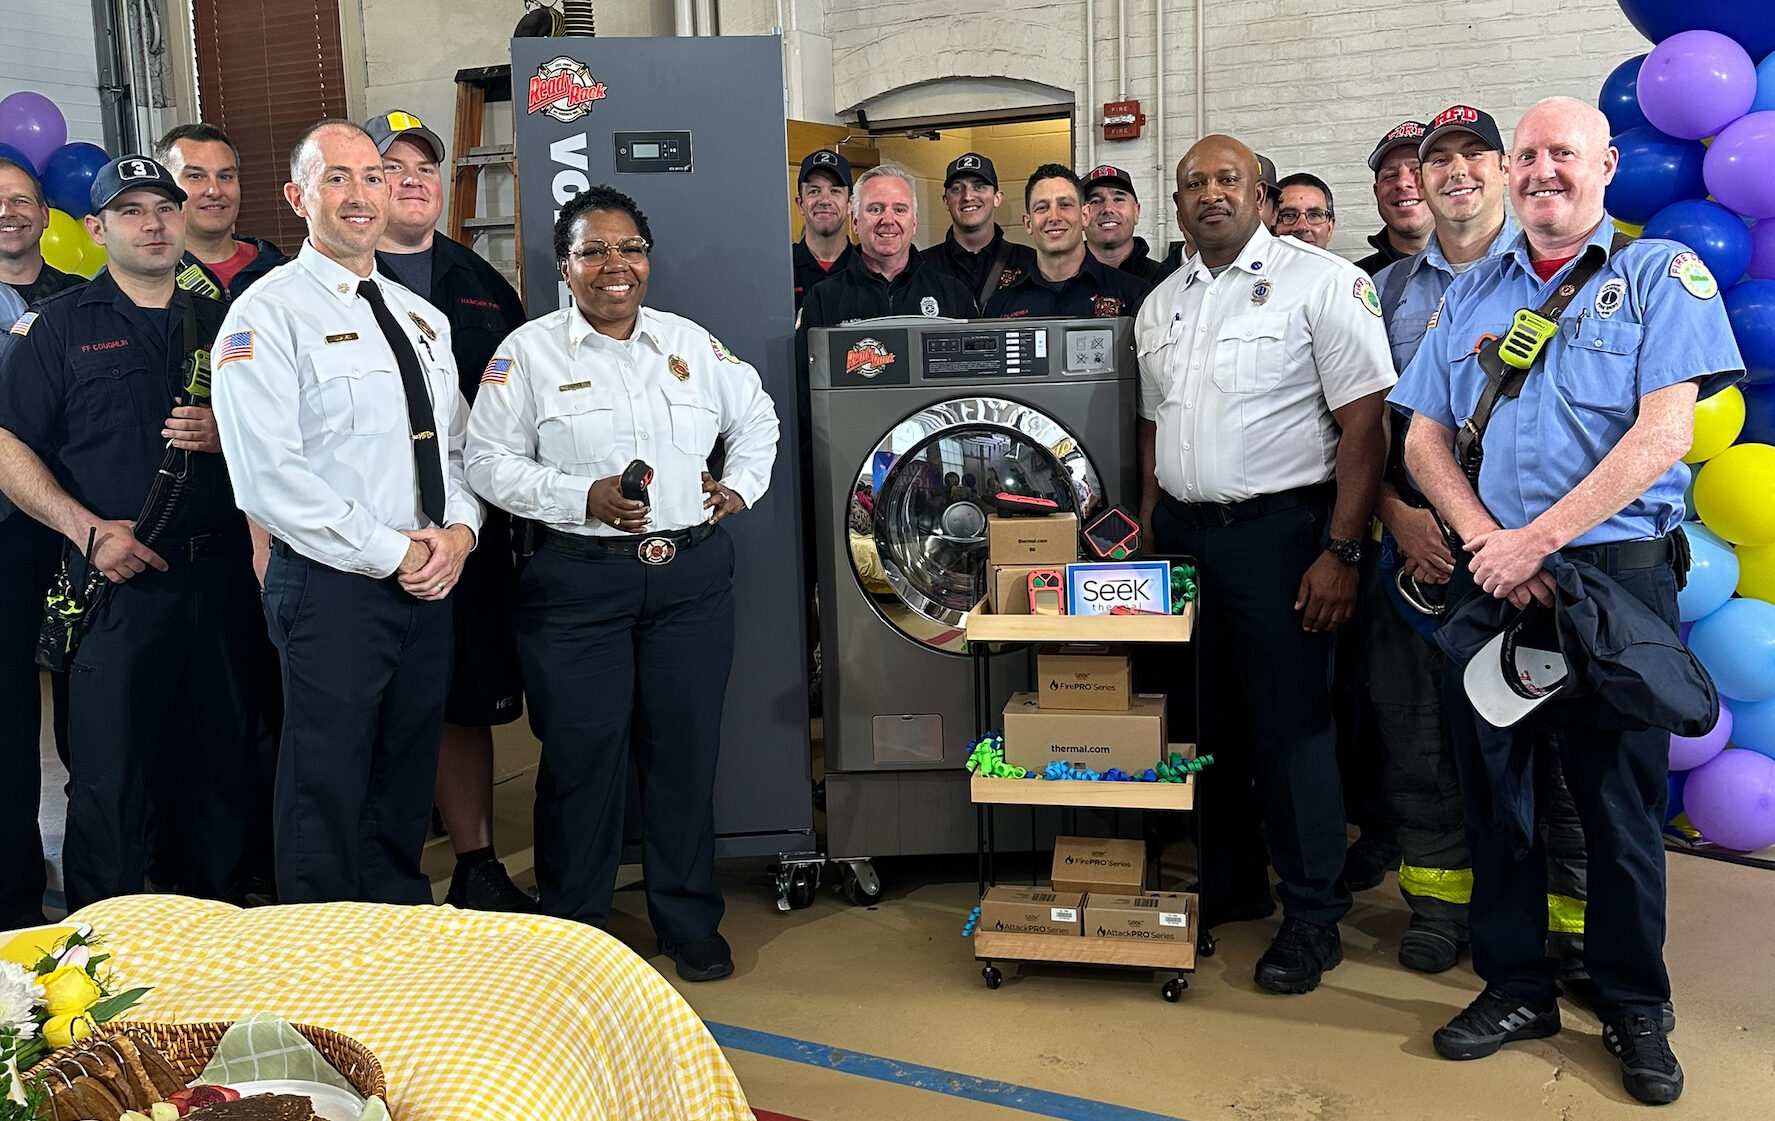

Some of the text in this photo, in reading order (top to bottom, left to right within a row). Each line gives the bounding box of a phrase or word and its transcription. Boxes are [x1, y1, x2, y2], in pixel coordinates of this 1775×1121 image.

[528, 69, 608, 107] Ready Rack
[1434, 107, 1478, 129] HFD
[820, 153, 830, 163] 2
[963, 157, 974, 167] 2
[131, 161, 147, 176] 3
[1671, 254, 1689, 275] FIRE
[81, 339, 129, 353] FF COUGHLIN
[1092, 683, 1116, 692] Series
[1050, 744, 1110, 754] thermal.com
[1106, 928, 1176, 941] AttackPRO Series
